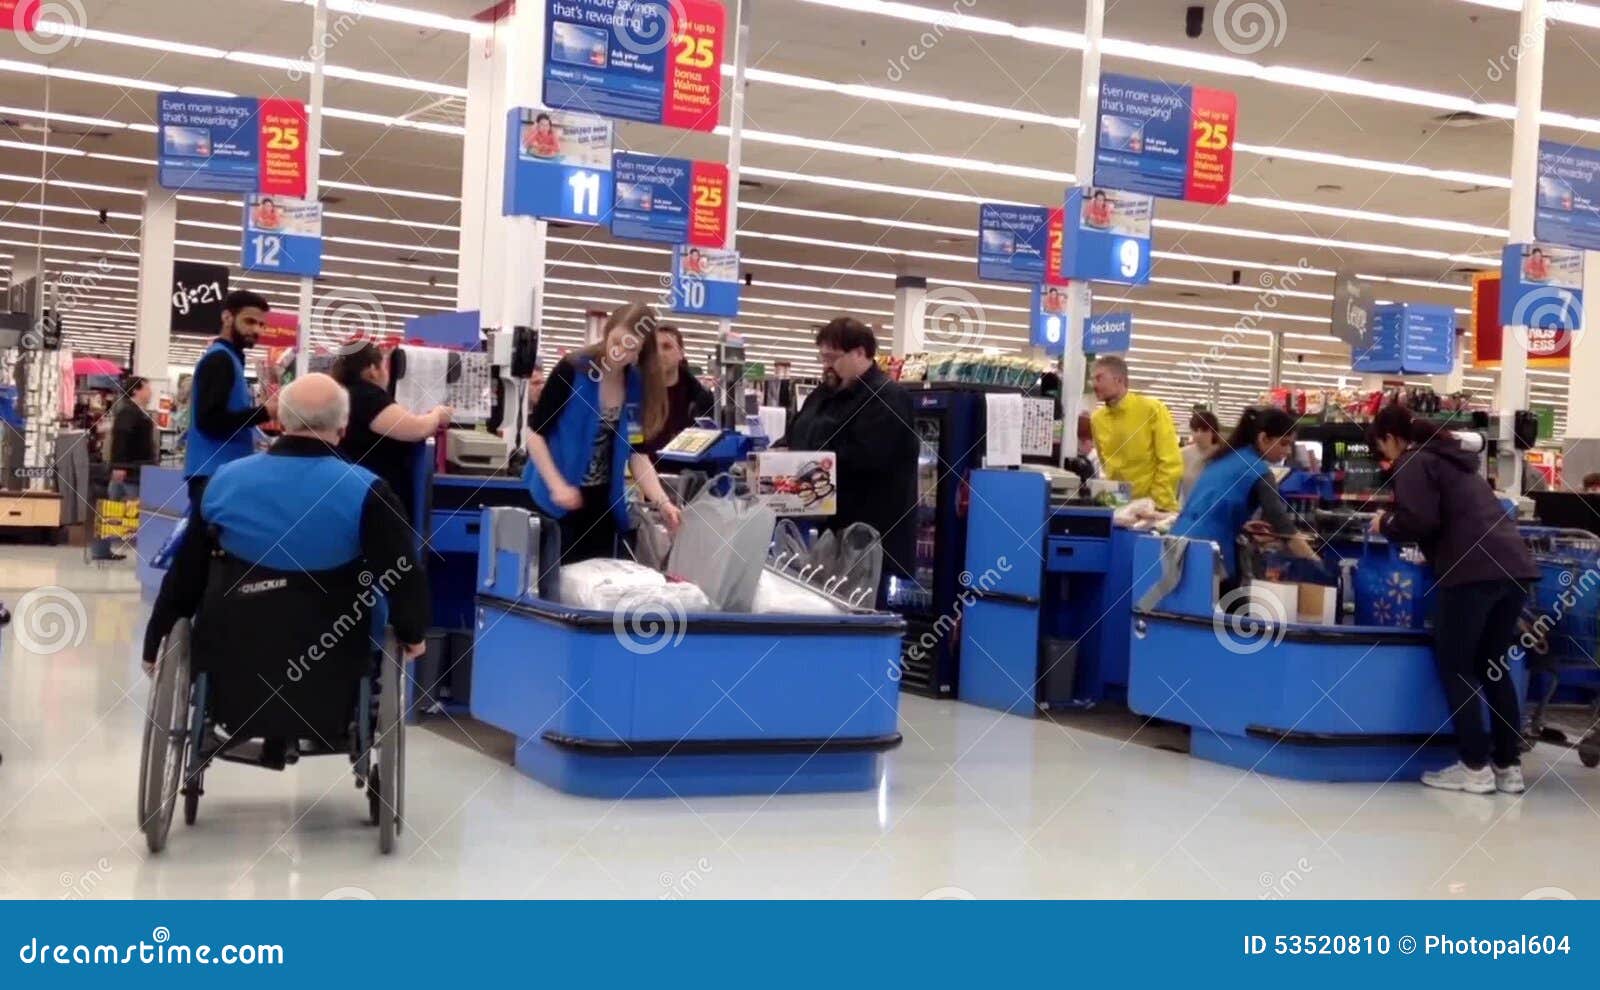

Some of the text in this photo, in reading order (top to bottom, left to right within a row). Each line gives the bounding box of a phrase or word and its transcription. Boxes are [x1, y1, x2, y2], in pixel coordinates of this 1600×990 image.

[553, 3, 643, 33] that's rewarding!
[1102, 83, 1124, 97] Even
[1125, 89, 1149, 102] more
[162, 99, 186, 110] Even
[188, 102, 213, 113] more
[1102, 98, 1172, 122] that's rewarding!
[162, 112, 239, 128] that's rewarding!
[616, 159, 634, 170] Even
[568, 171, 600, 216] 11
[252, 235, 280, 266] 12
[1120, 239, 1140, 278] 9
[682, 281, 705, 309] 10
[1558, 290, 1572, 322] 7
[1090, 321, 1125, 334] heckout
[241, 579, 287, 593] QUICKIE
